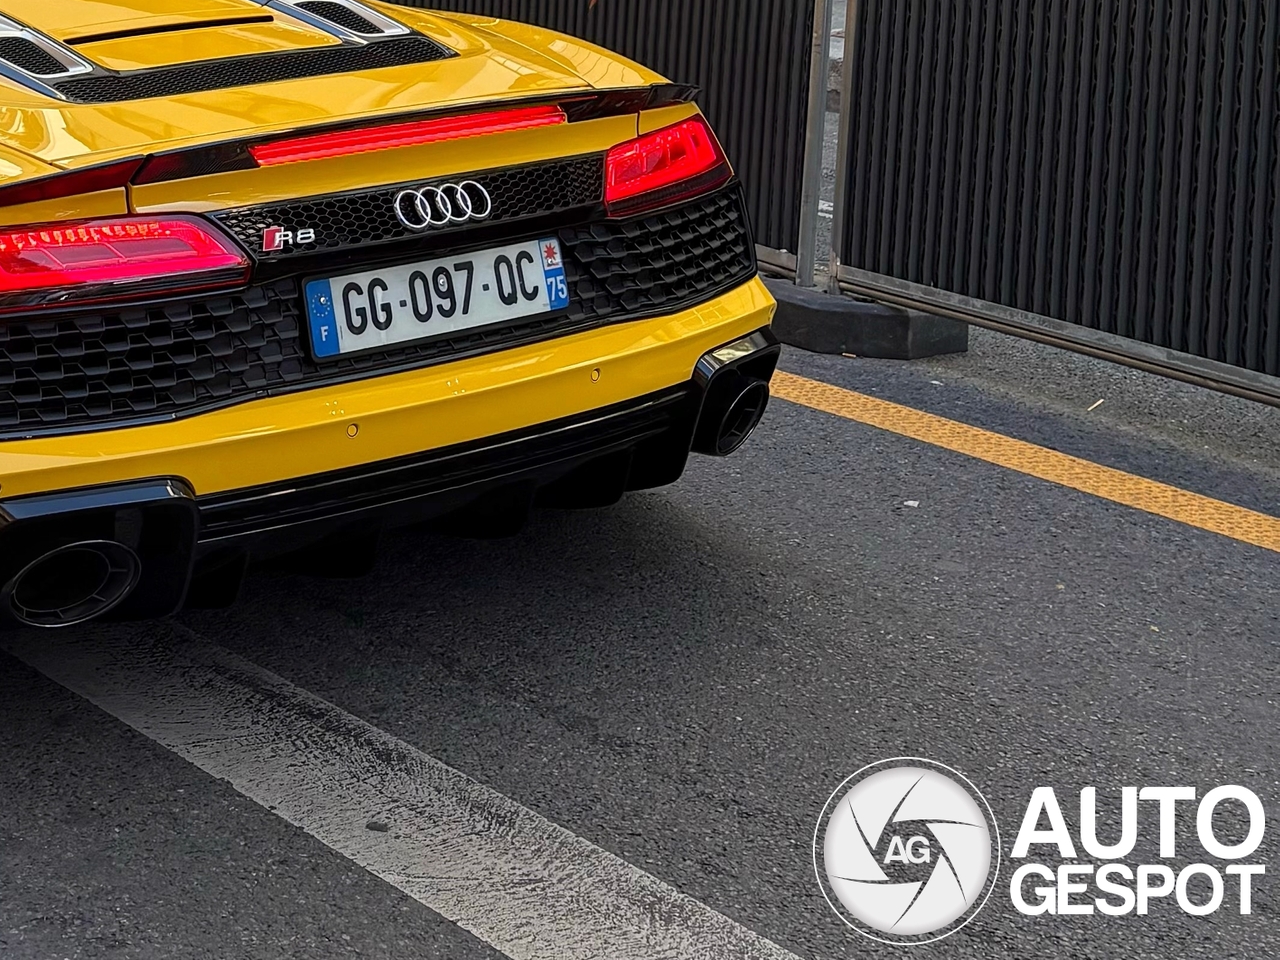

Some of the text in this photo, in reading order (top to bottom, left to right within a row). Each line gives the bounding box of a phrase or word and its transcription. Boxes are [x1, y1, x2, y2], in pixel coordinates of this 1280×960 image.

[274, 227, 316, 247] R8
[320, 250, 567, 342] F GG-097-QC 75
